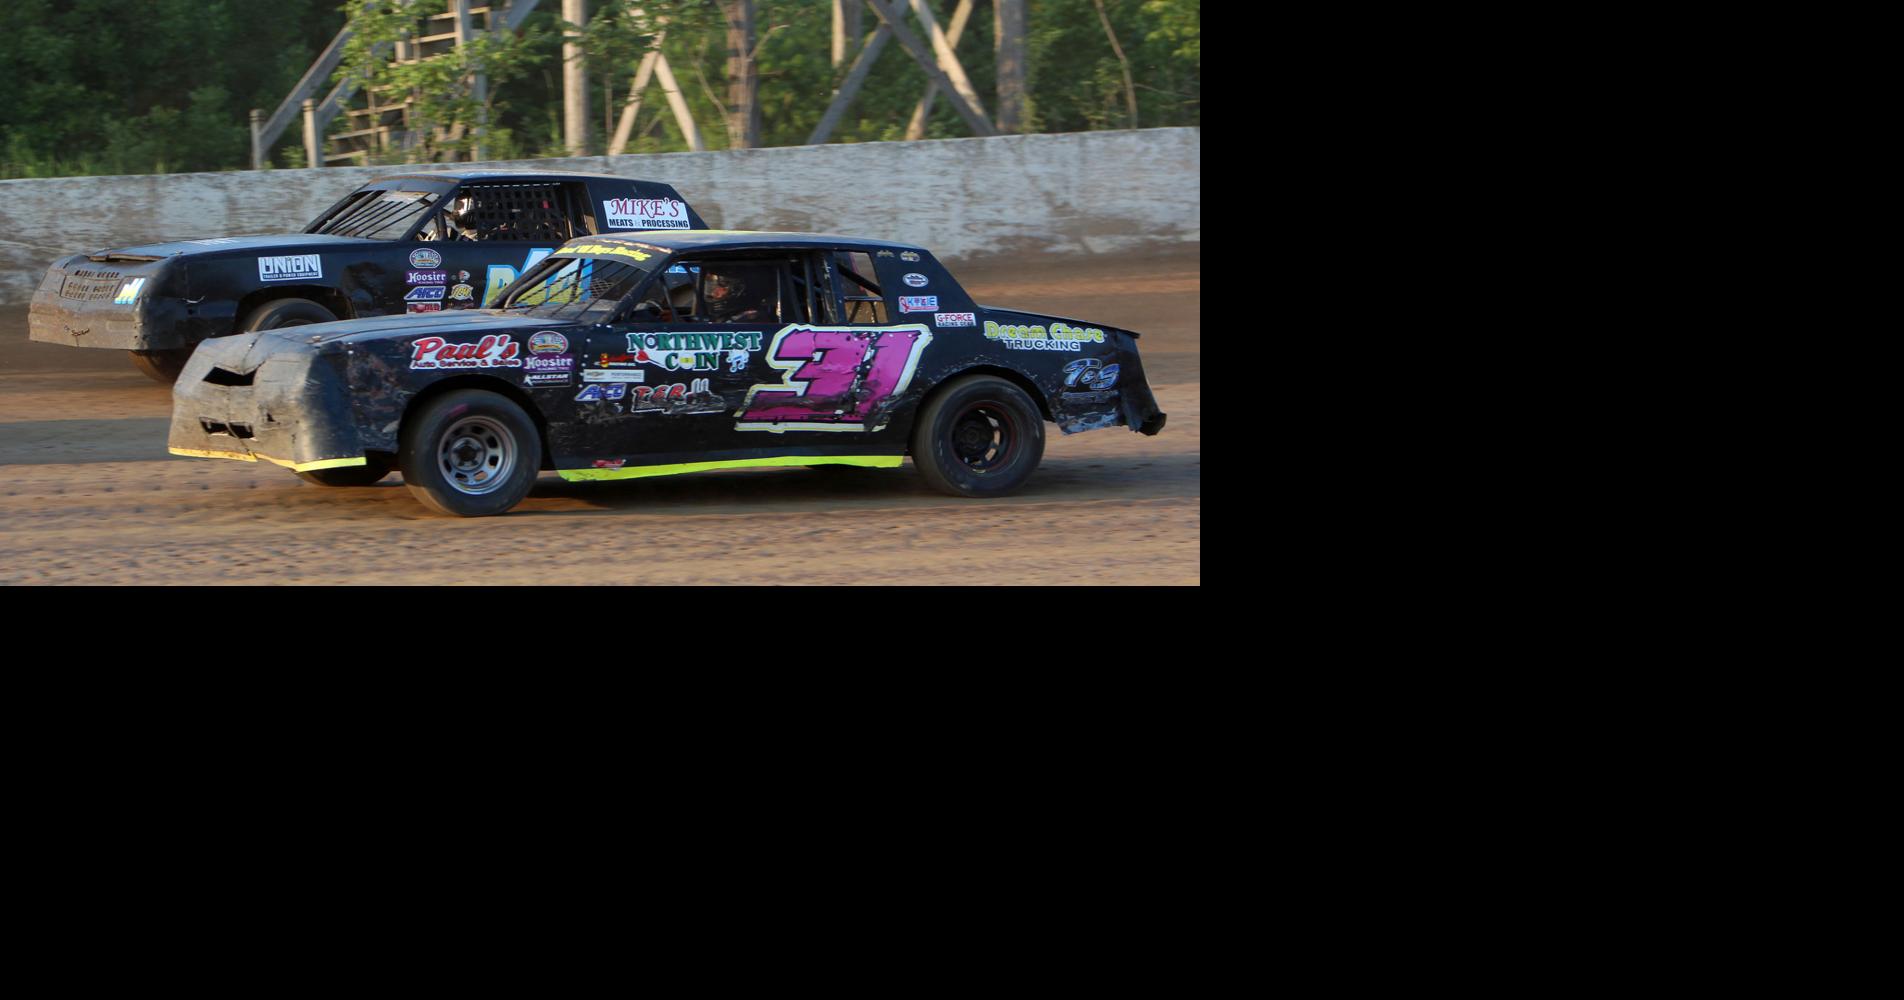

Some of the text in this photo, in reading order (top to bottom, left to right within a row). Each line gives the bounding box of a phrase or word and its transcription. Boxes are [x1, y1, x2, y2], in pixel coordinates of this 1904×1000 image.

[610, 197, 680, 218] MIKE'S
[608, 219, 634, 227] MEATS
[642, 219, 689, 228] PROCESSING
[406, 271, 447, 283] Hoosier
[984, 320, 1105, 343] Dream Chase
[412, 335, 520, 361] Paul's
[627, 332, 762, 351] NORTHWEST
[1004, 339, 1081, 352] TRUCKING
[412, 359, 520, 368] Auto Service & Sales
[523, 355, 573, 369] Hoosier
[737, 324, 931, 432] 31
